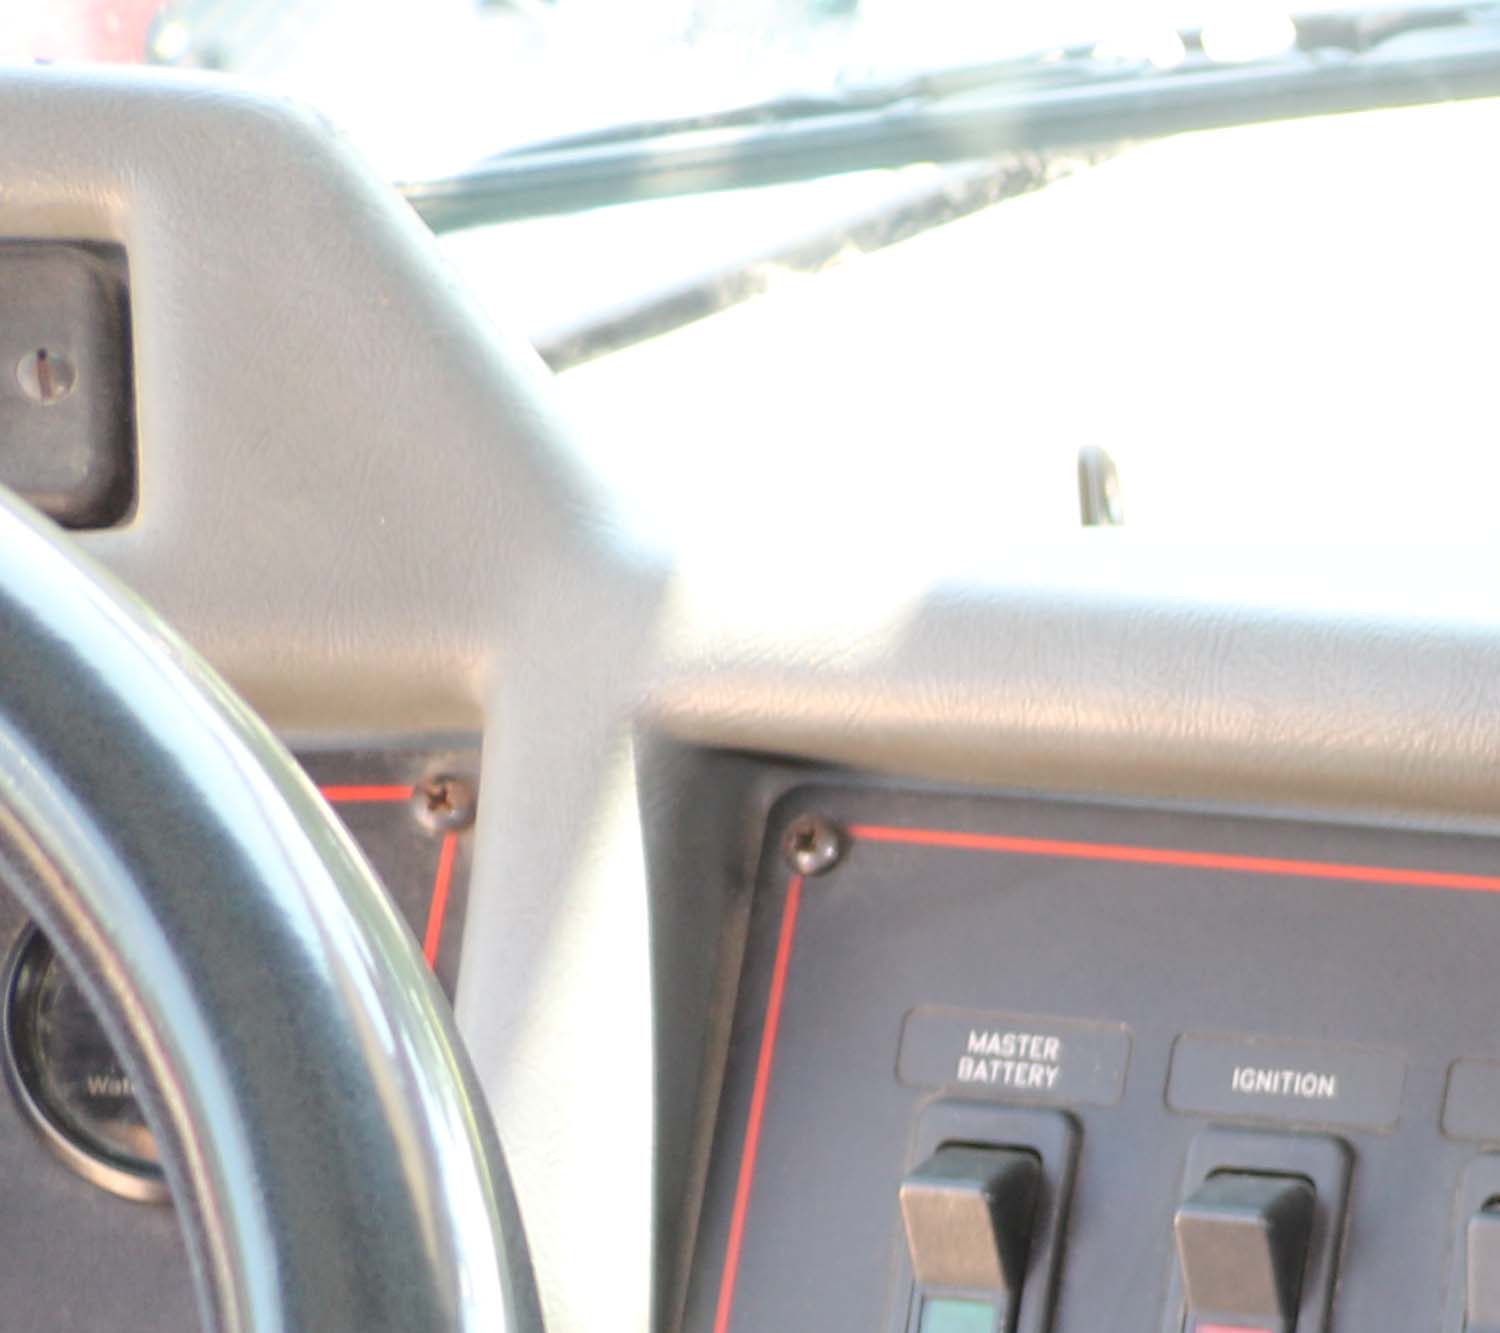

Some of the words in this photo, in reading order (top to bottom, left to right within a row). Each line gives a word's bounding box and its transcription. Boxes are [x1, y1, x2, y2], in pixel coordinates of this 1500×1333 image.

[967, 1029, 1061, 1061] MASTER
[956, 1056, 1061, 1089] BATTERY
[1231, 1066, 1336, 1097] IGNITION
